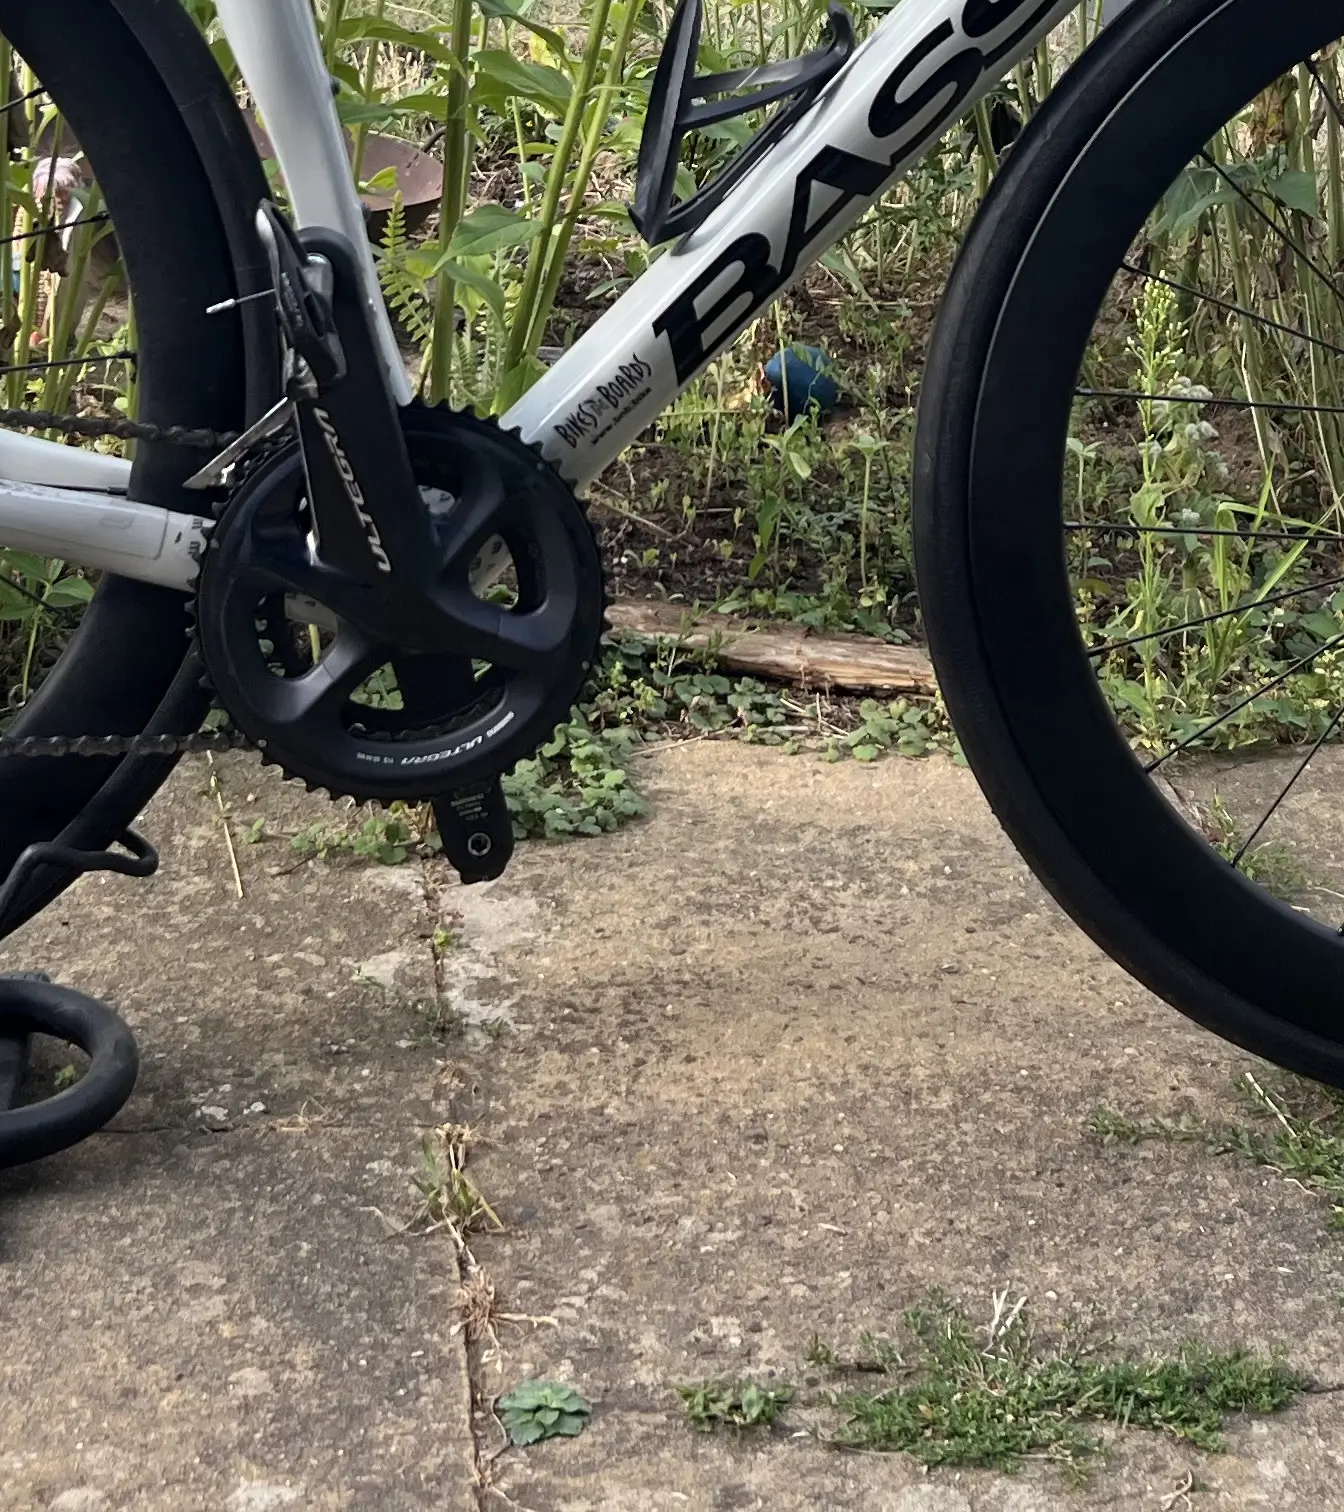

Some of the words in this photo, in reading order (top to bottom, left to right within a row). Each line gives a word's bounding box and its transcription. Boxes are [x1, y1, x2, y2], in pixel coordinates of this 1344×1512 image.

[553, 403, 598, 449] BIKES
[596, 352, 652, 409] BOARDS
[313, 407, 391, 572] ULTEGRA
